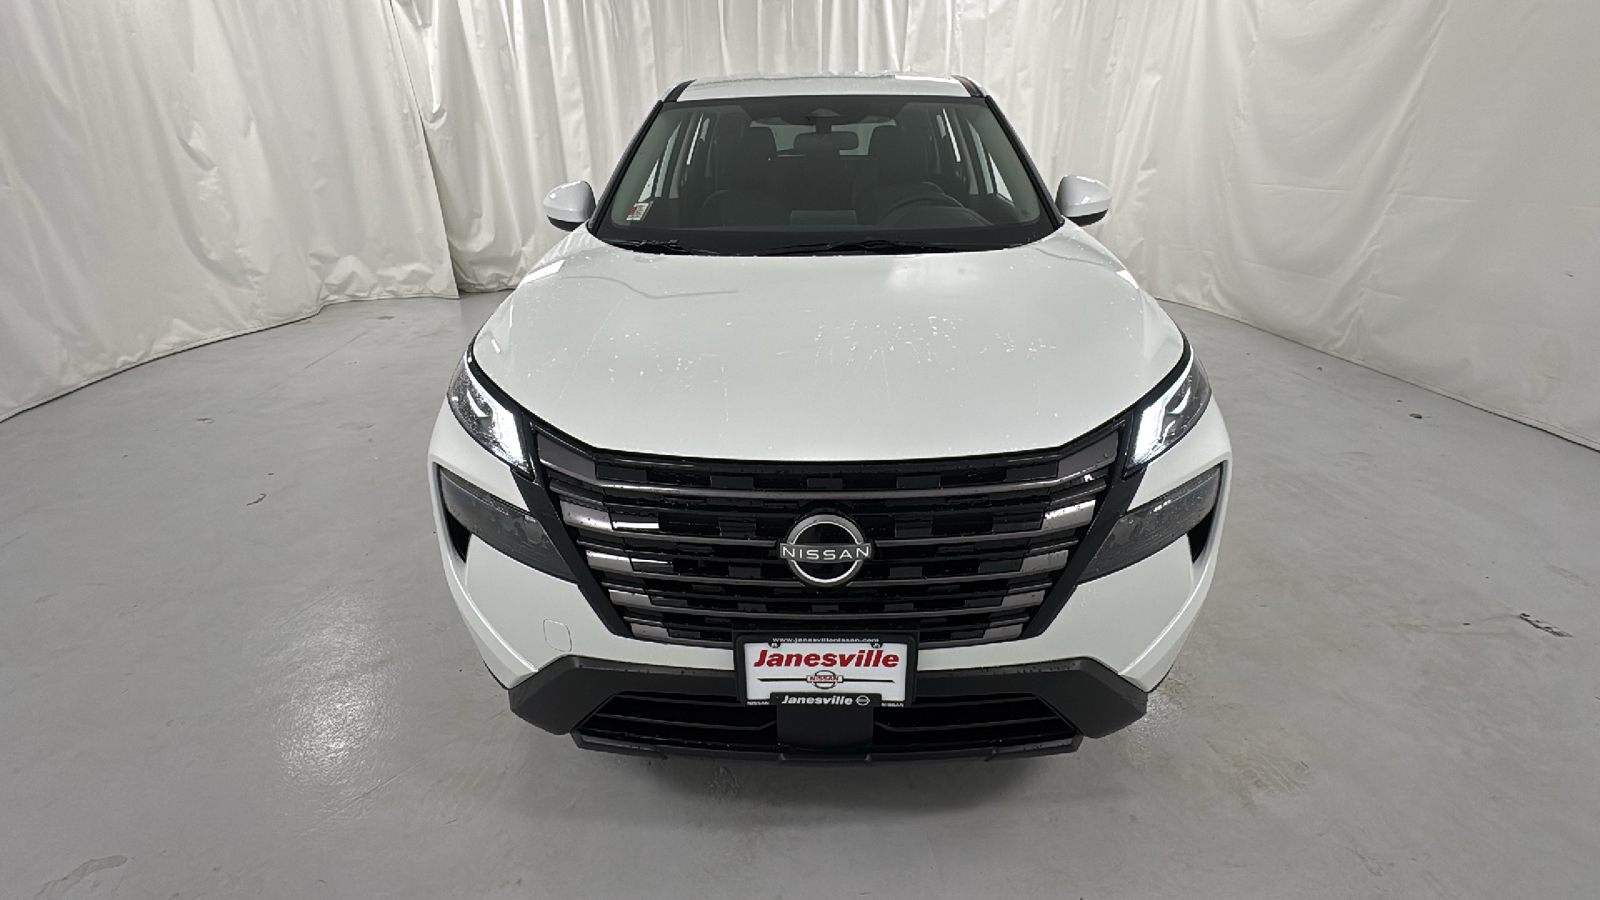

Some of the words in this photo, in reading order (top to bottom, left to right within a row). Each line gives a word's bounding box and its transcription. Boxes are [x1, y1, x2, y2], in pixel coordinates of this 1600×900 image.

[782, 546, 869, 560] NISSAN
[753, 649, 900, 668] Janesville
[781, 695, 854, 706] Janesville
